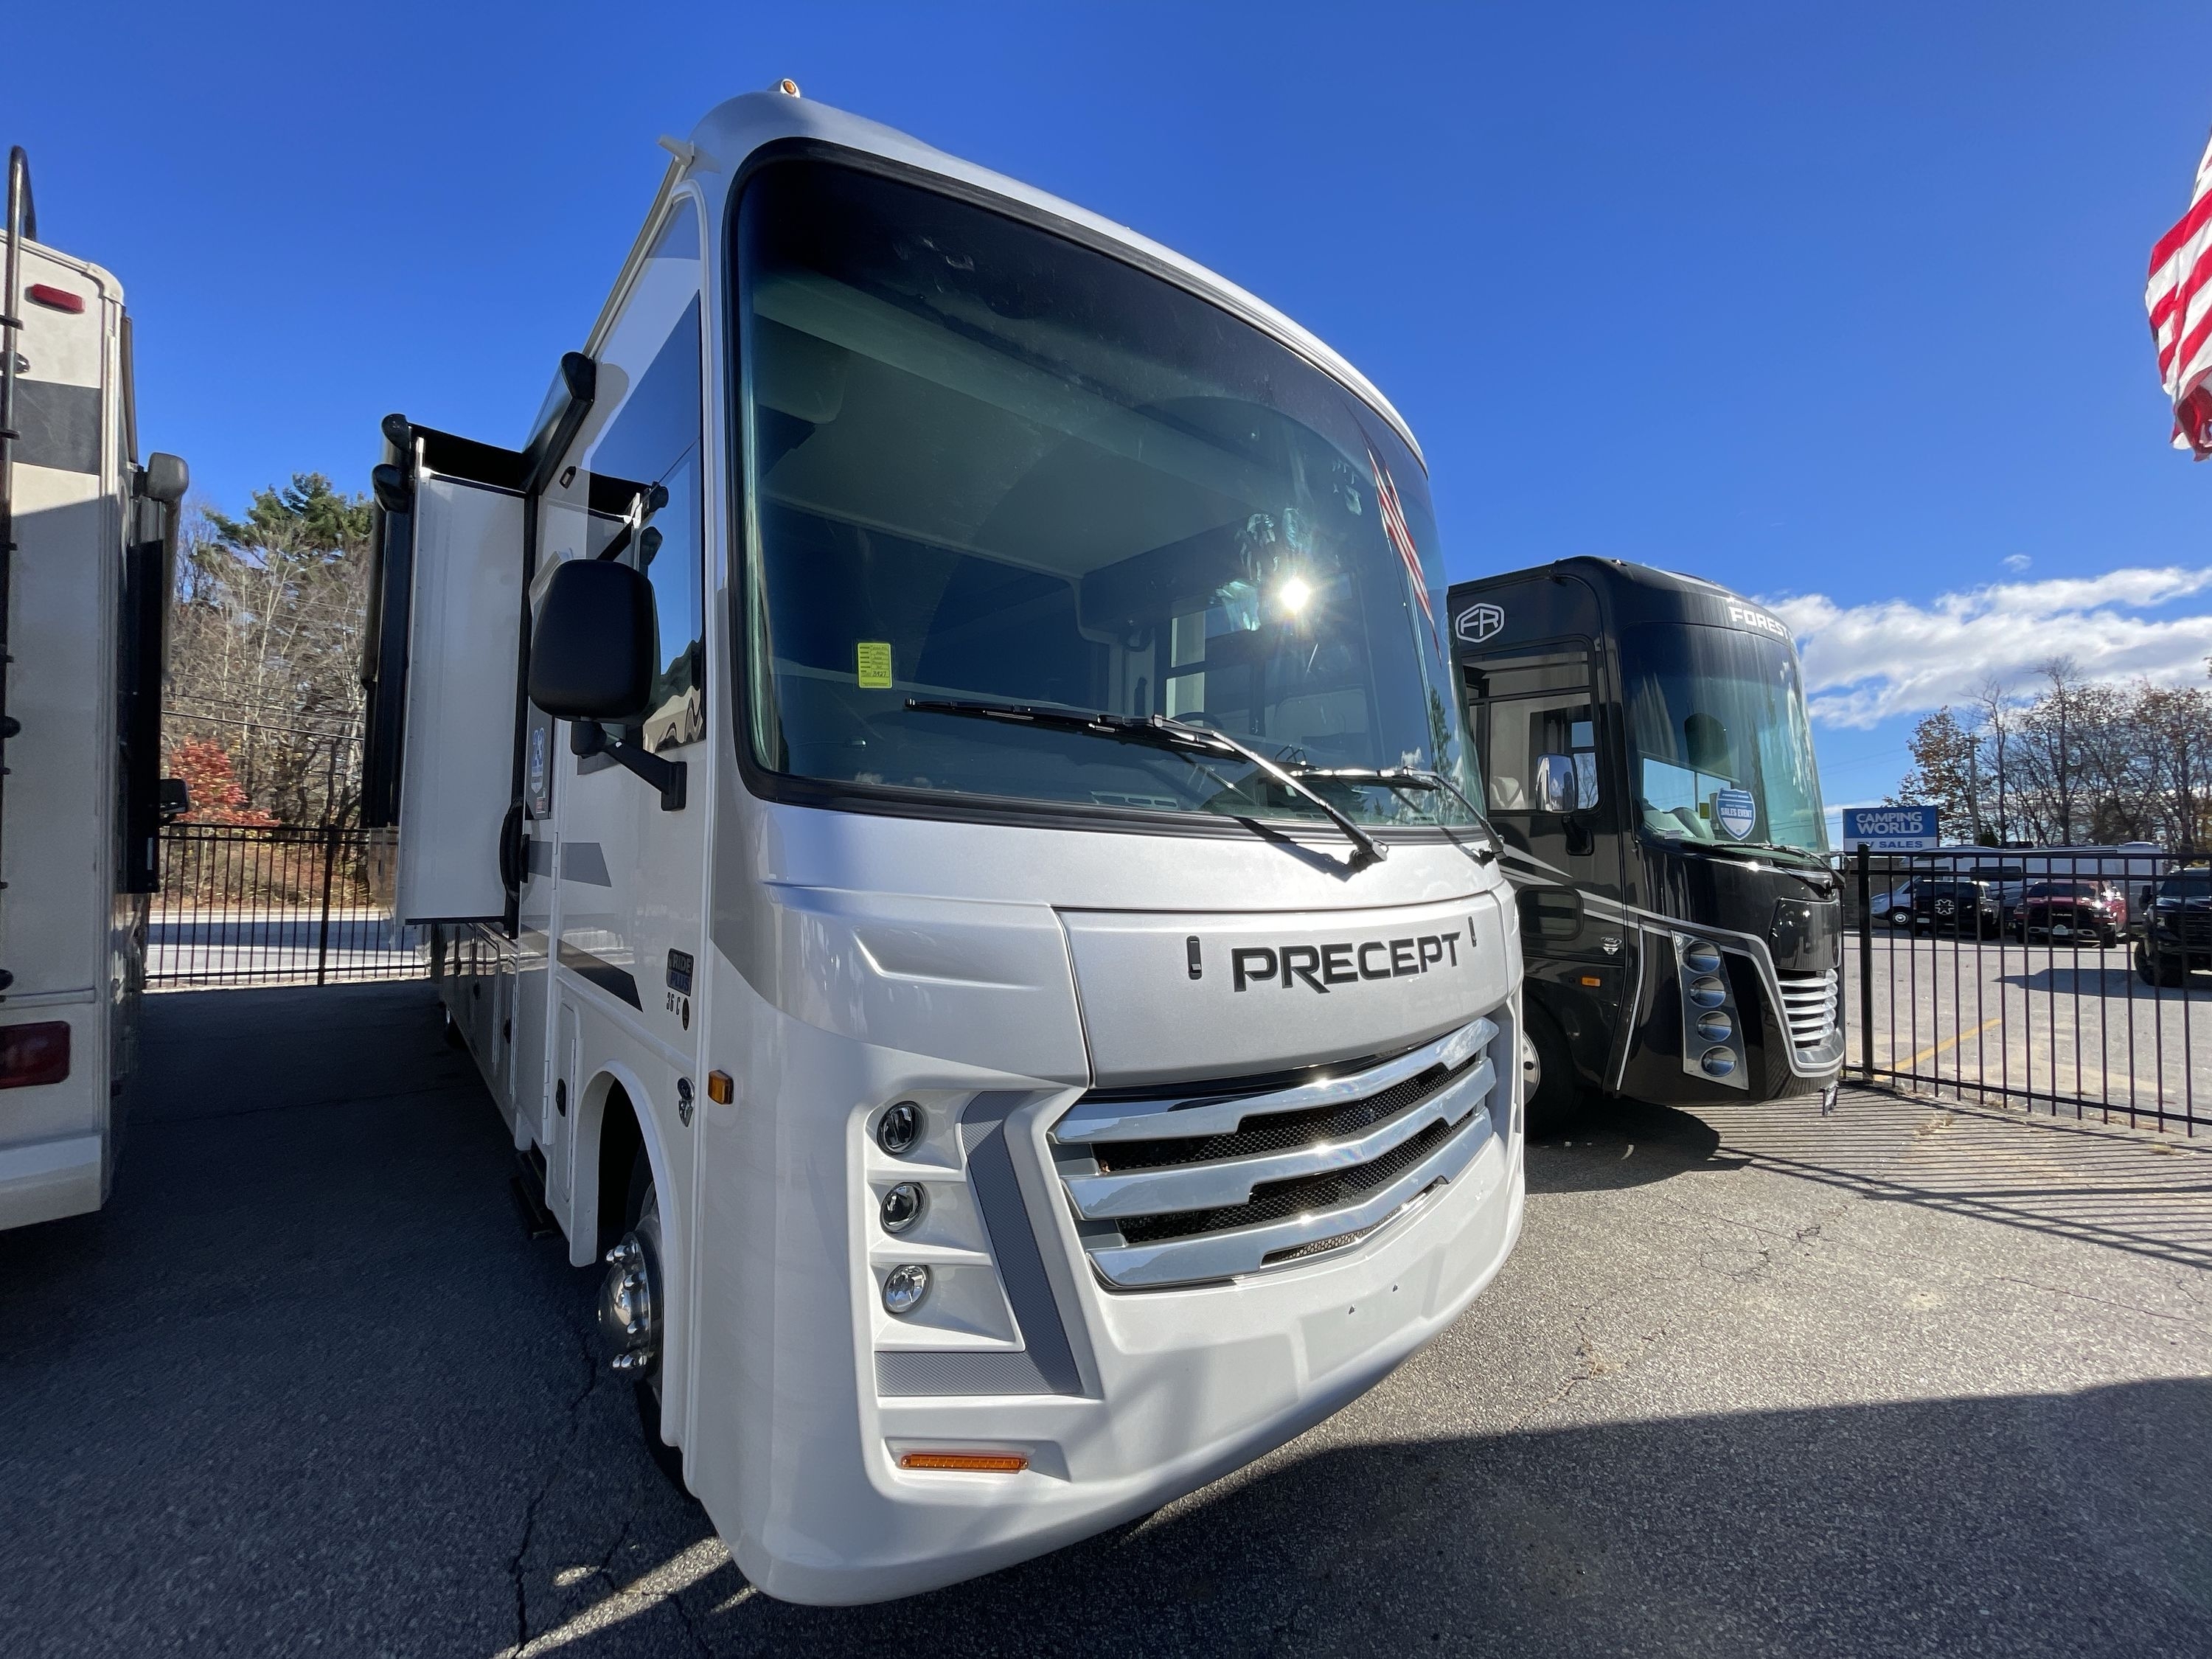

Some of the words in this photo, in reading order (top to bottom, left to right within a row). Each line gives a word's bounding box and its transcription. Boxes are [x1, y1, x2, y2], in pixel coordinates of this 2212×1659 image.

[1460, 608, 1499, 637] FR
[1728, 606, 1788, 639] FOREST
[1720, 807, 1737, 816] SALES
[1737, 809, 1753, 818] EVENT
[1856, 812, 1922, 823] CAMPING
[1857, 822, 1923, 835] WORLD
[1879, 841, 1923, 849] SALES
[1231, 931, 1461, 994] PRECEPT
[670, 971, 690, 992] PLUS
[667, 992, 675, 1012] 36
[675, 996, 681, 1015] C
